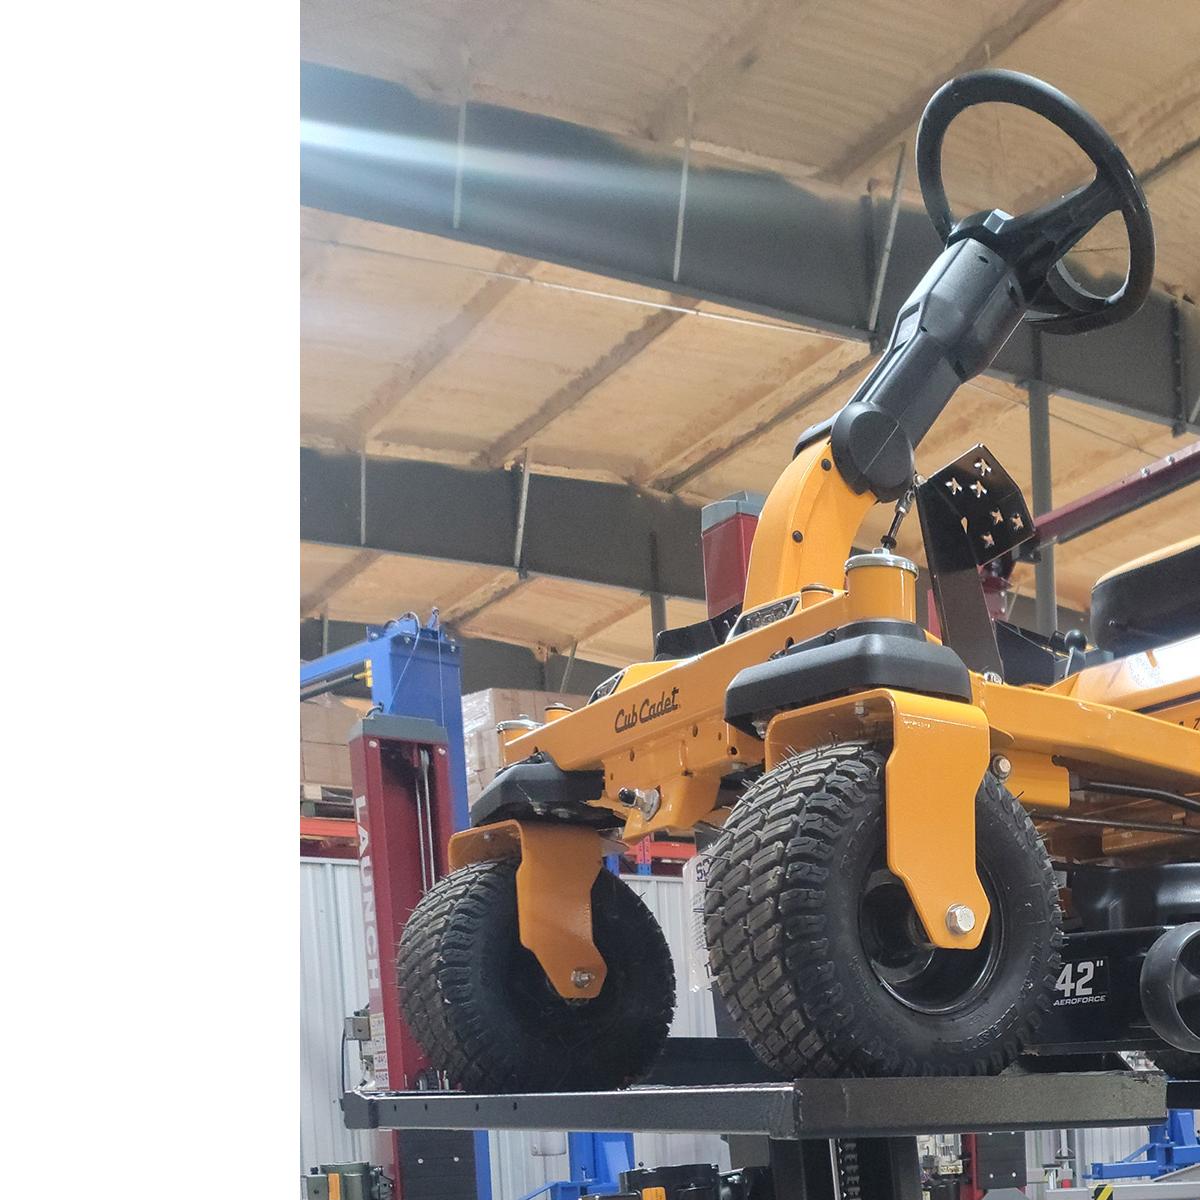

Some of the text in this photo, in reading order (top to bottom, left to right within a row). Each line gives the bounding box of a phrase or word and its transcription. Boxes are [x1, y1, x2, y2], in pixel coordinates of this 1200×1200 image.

[615, 687, 680, 733] Cub Cadet
[355, 795, 380, 989] LAUNCH
[1053, 995, 1107, 1007] AEROFORCE
